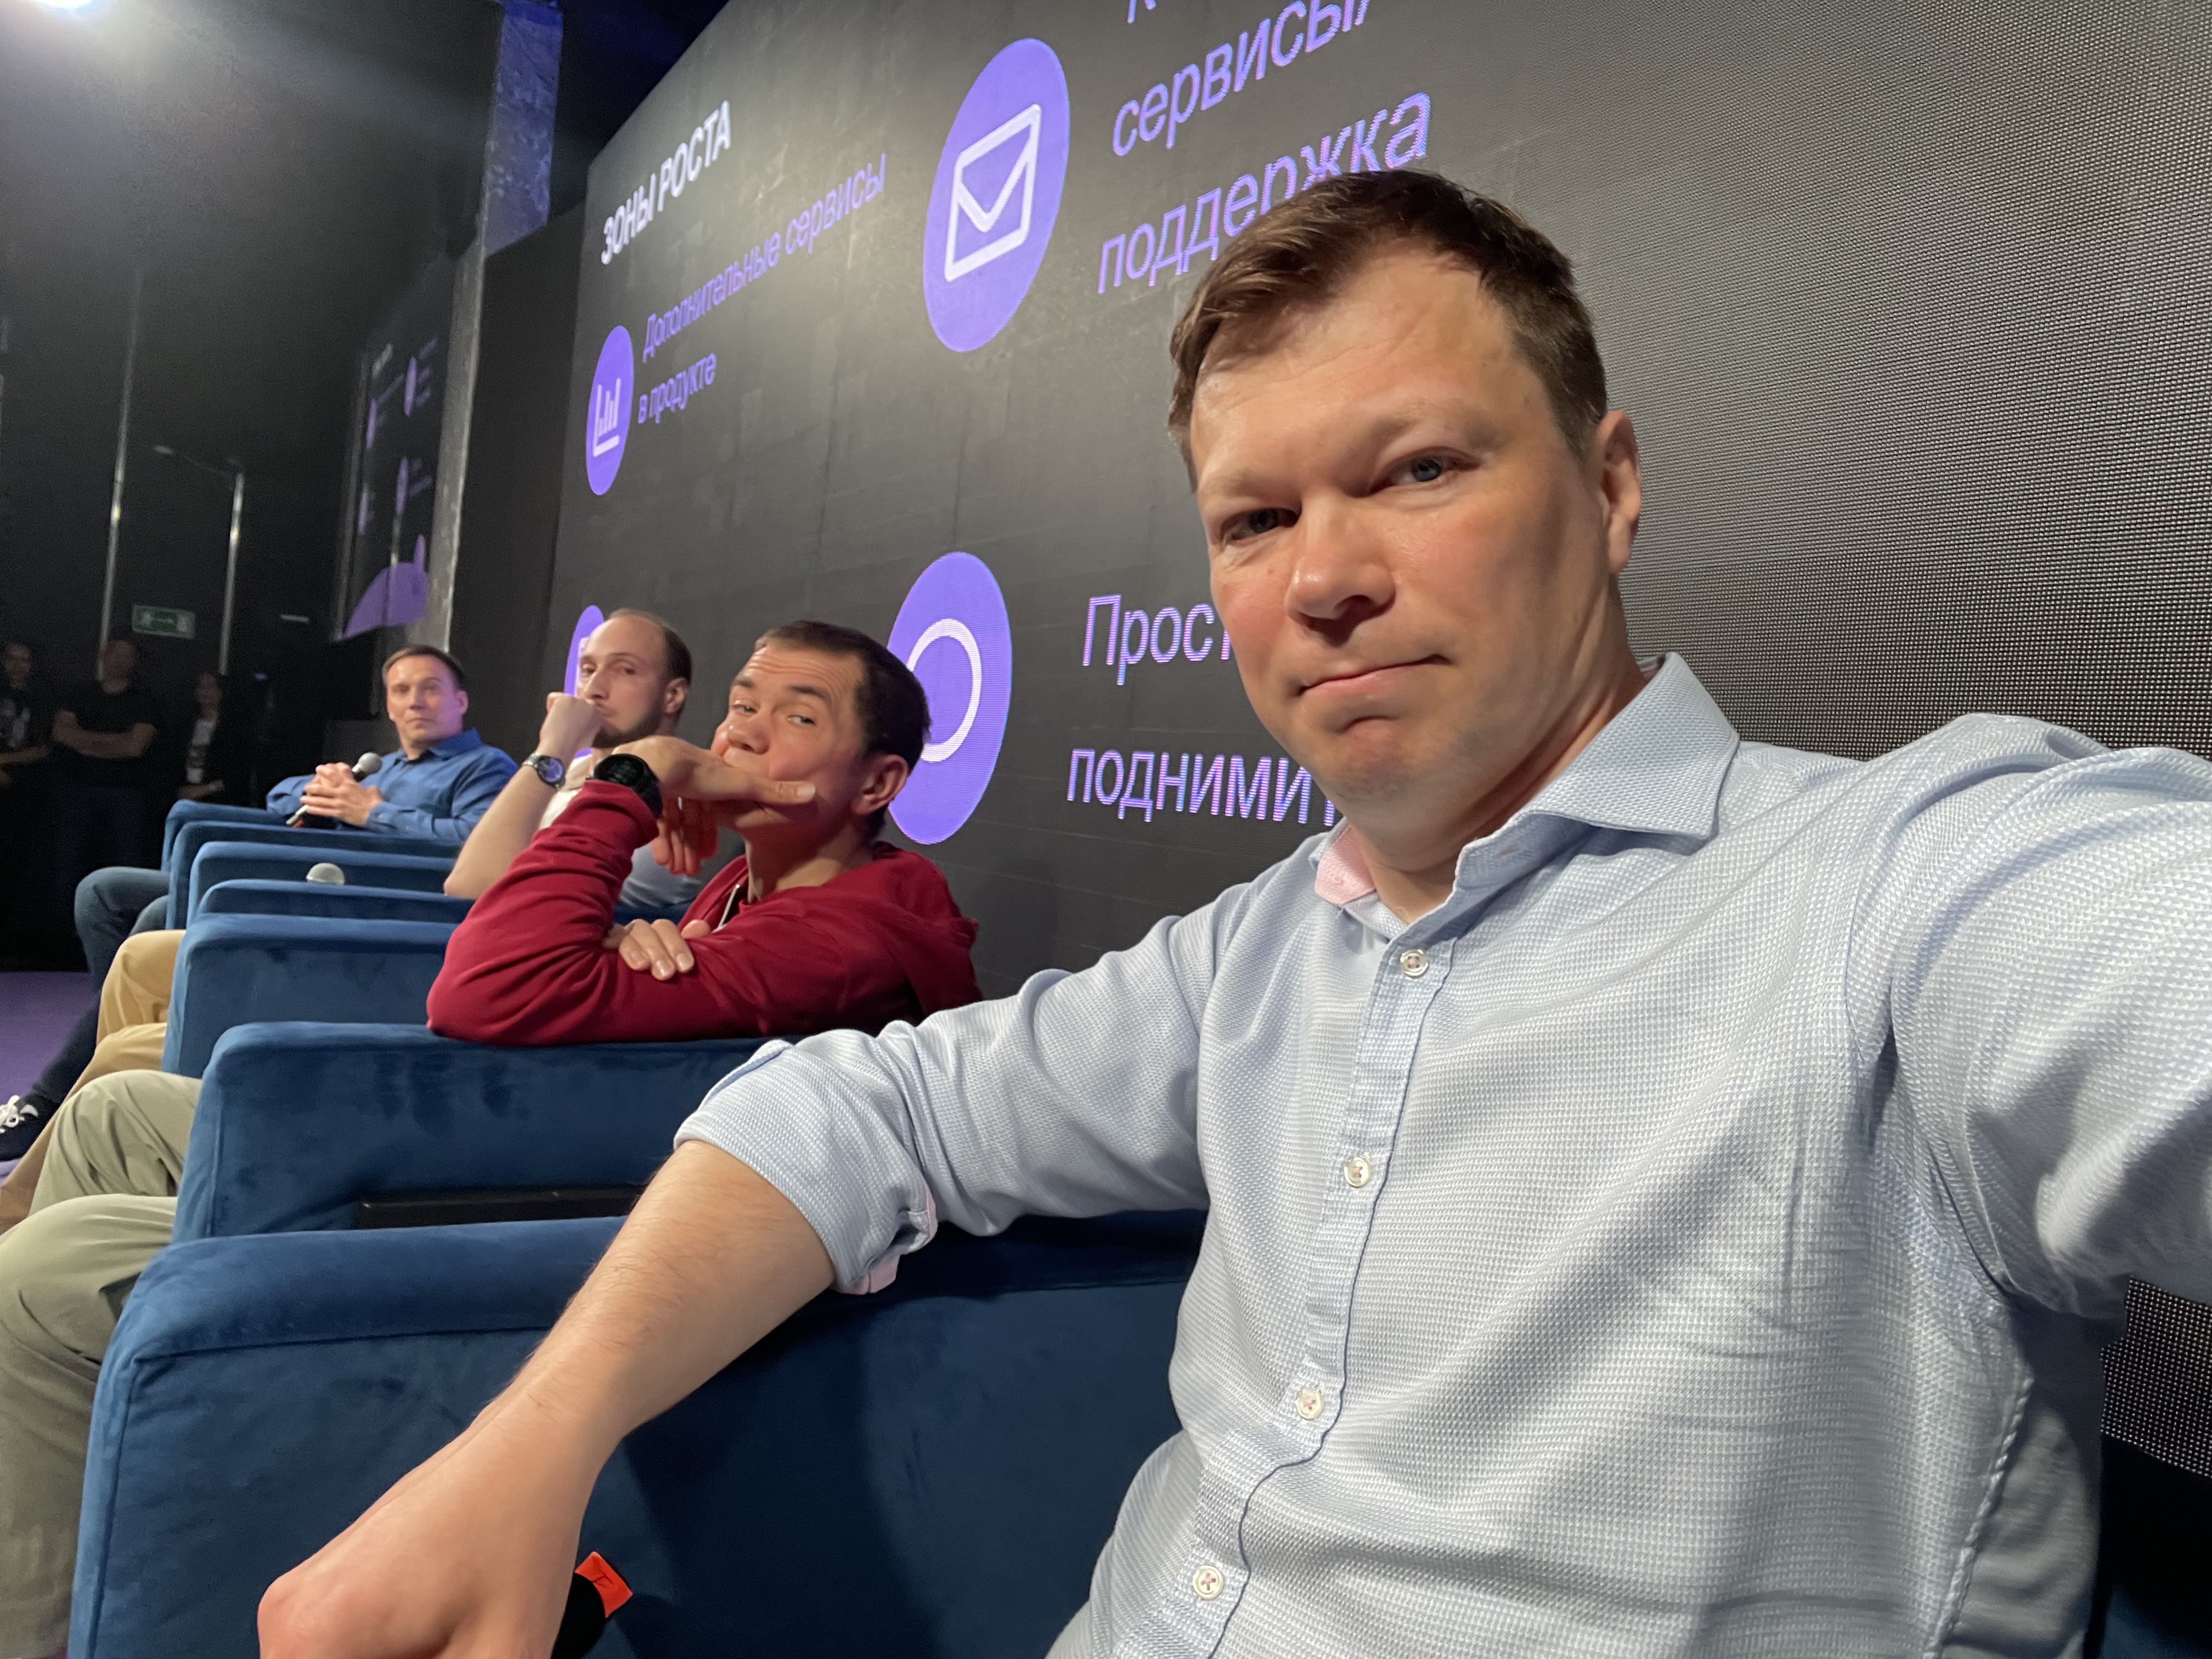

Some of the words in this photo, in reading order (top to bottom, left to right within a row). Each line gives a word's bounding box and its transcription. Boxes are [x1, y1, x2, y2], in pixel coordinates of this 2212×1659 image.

[601, 172, 657, 264] ЗОНЫ
[657, 100, 731, 211] РОСТА
[642, 231, 782, 363] Дополнительные
[786, 153, 887, 255] сервисы
[637, 394, 648, 424] в
[648, 352, 717, 424] продукте
[1066, 748, 1336, 827] подними
